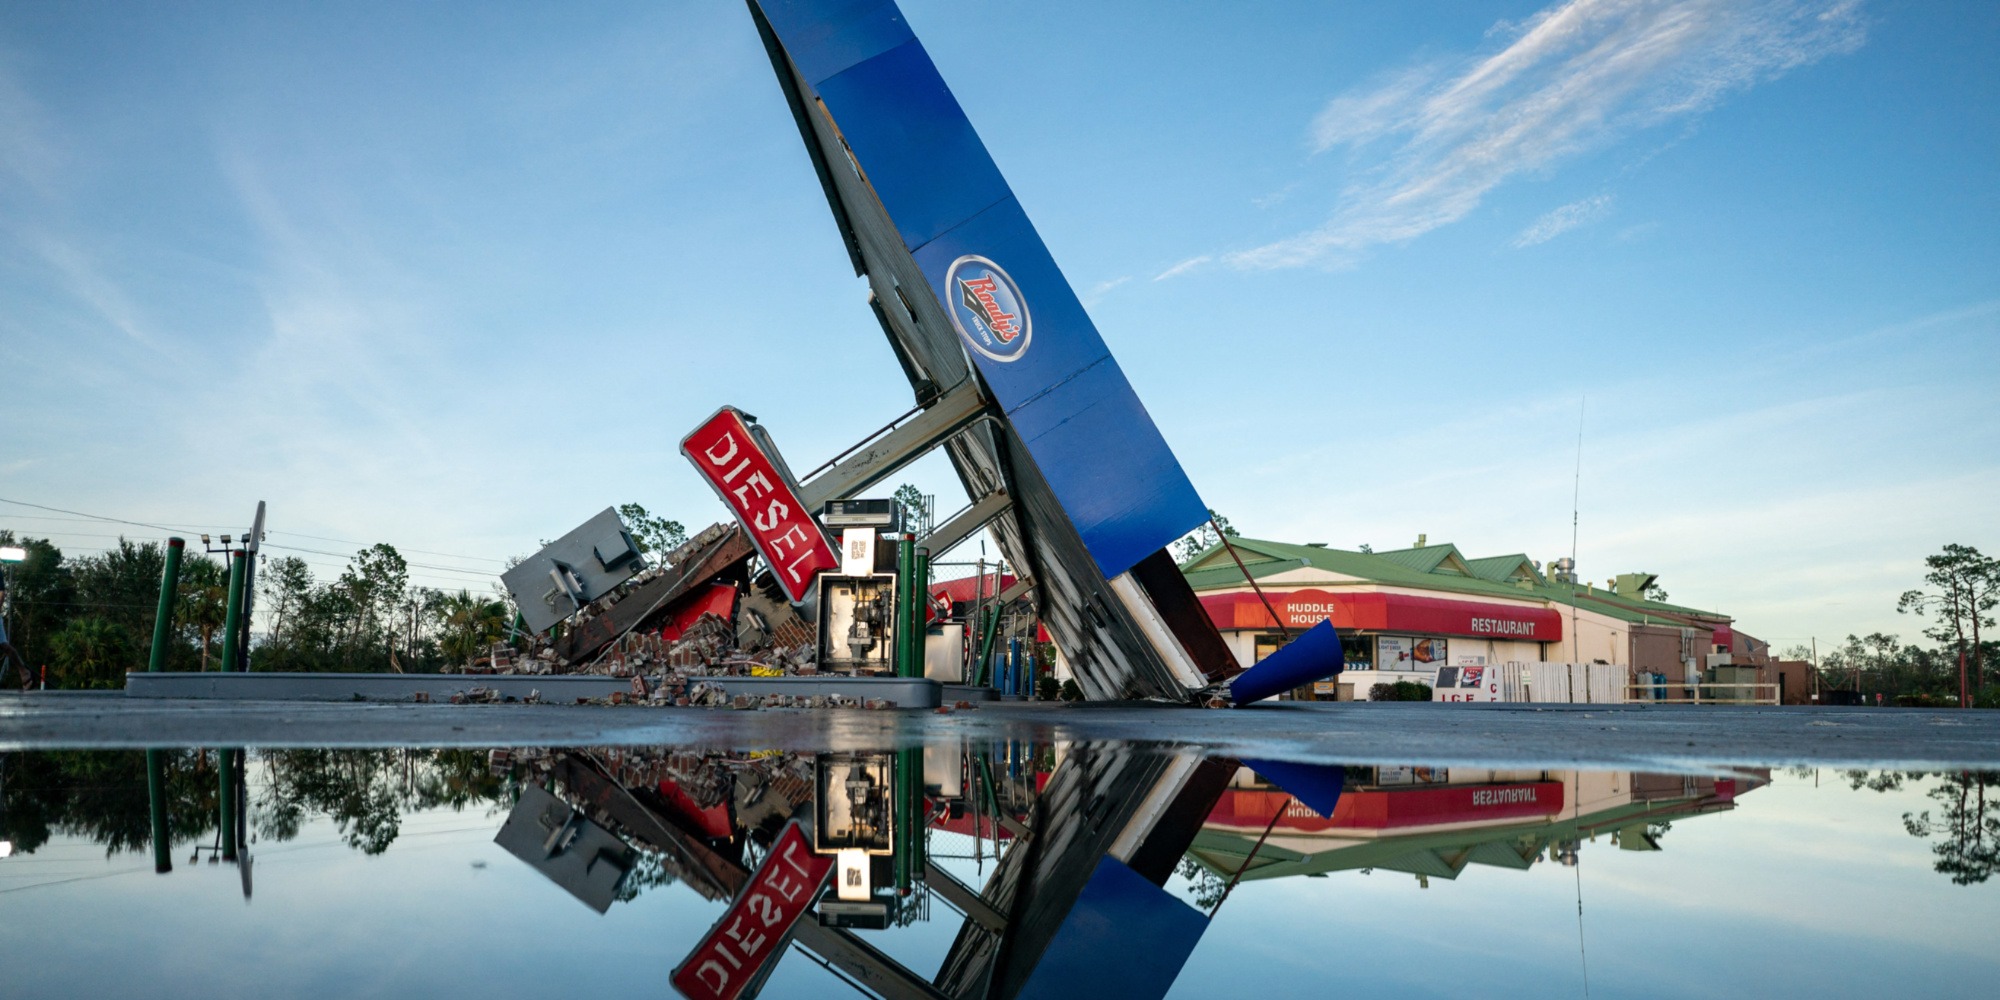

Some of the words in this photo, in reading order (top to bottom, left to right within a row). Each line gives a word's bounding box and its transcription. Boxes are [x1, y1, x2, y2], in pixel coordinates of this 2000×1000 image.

[963, 273, 1020, 341] Roady's
[971, 315, 984, 332] TRUCK
[980, 329, 992, 346] STOPS
[705, 431, 814, 583] DIESEL
[1287, 603, 1334, 613] HUDDLE
[1471, 617, 1535, 636] RESTAURANT
